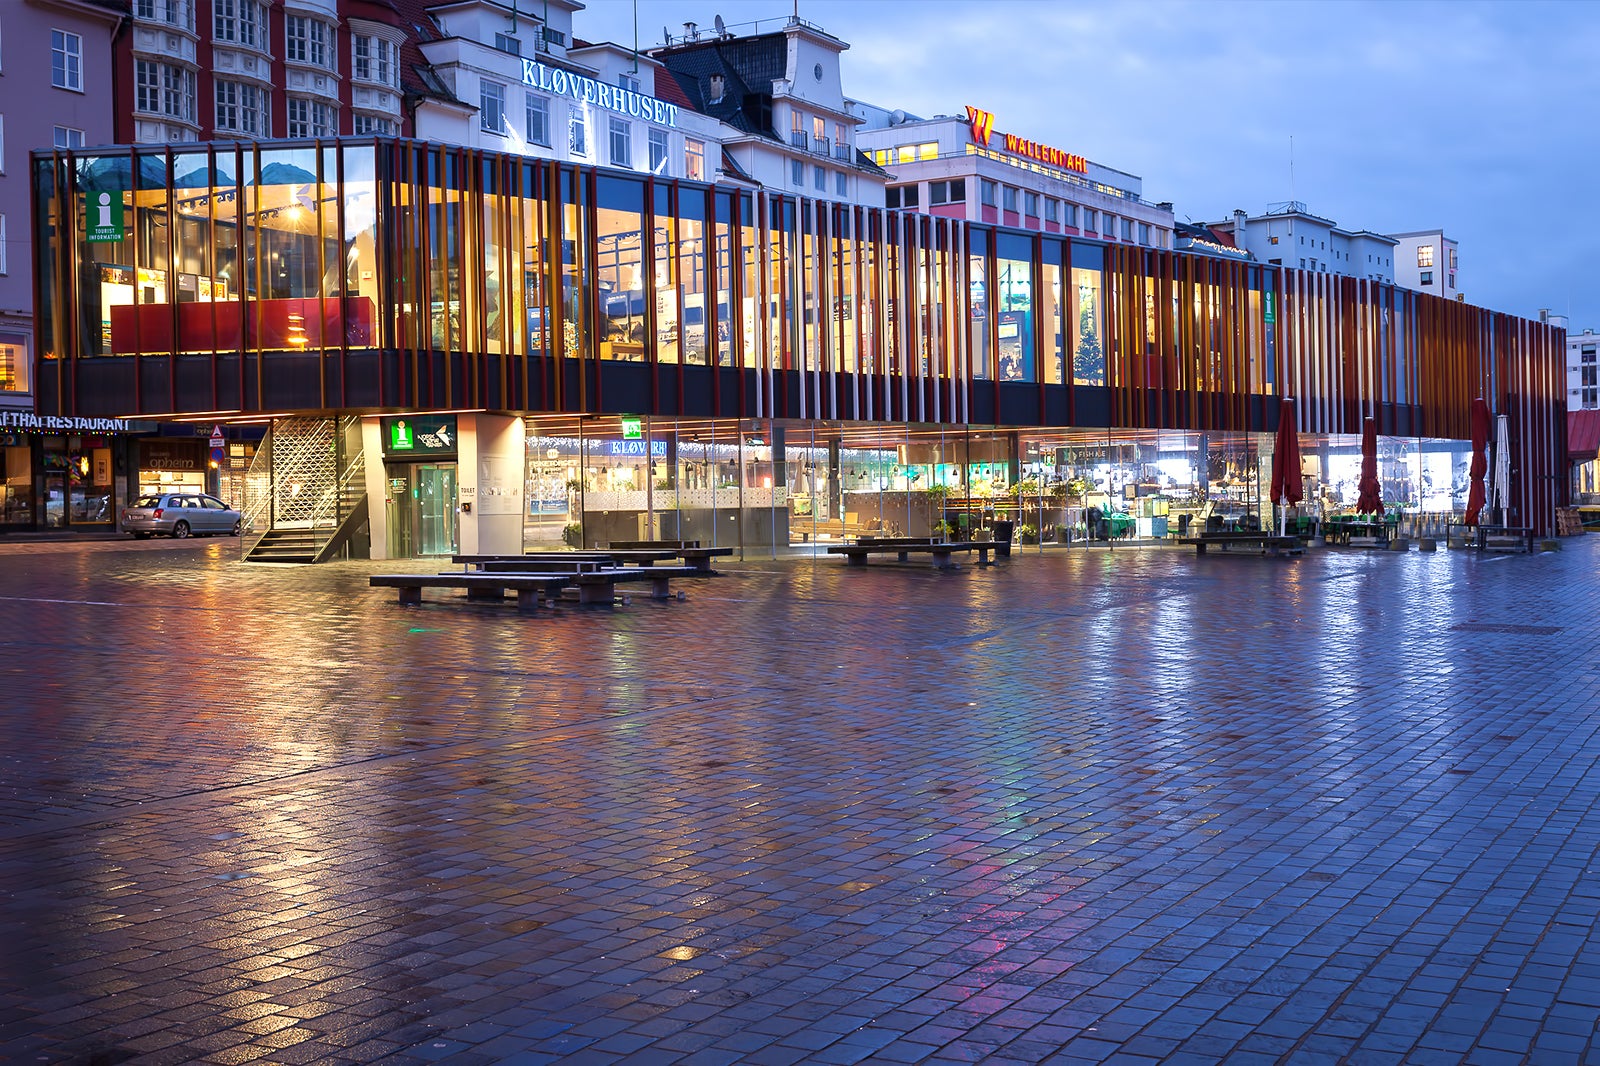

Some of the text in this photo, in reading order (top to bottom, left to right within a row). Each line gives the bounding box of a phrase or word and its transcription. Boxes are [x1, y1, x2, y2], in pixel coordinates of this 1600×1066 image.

[520, 57, 679, 128] KLØVERHUSET
[1005, 133, 1088, 174] WALLENDAHL
[10, 412, 42, 427] THAI
[47, 416, 130, 431] RESTAURANT
[611, 441, 667, 454] KLØVRH
